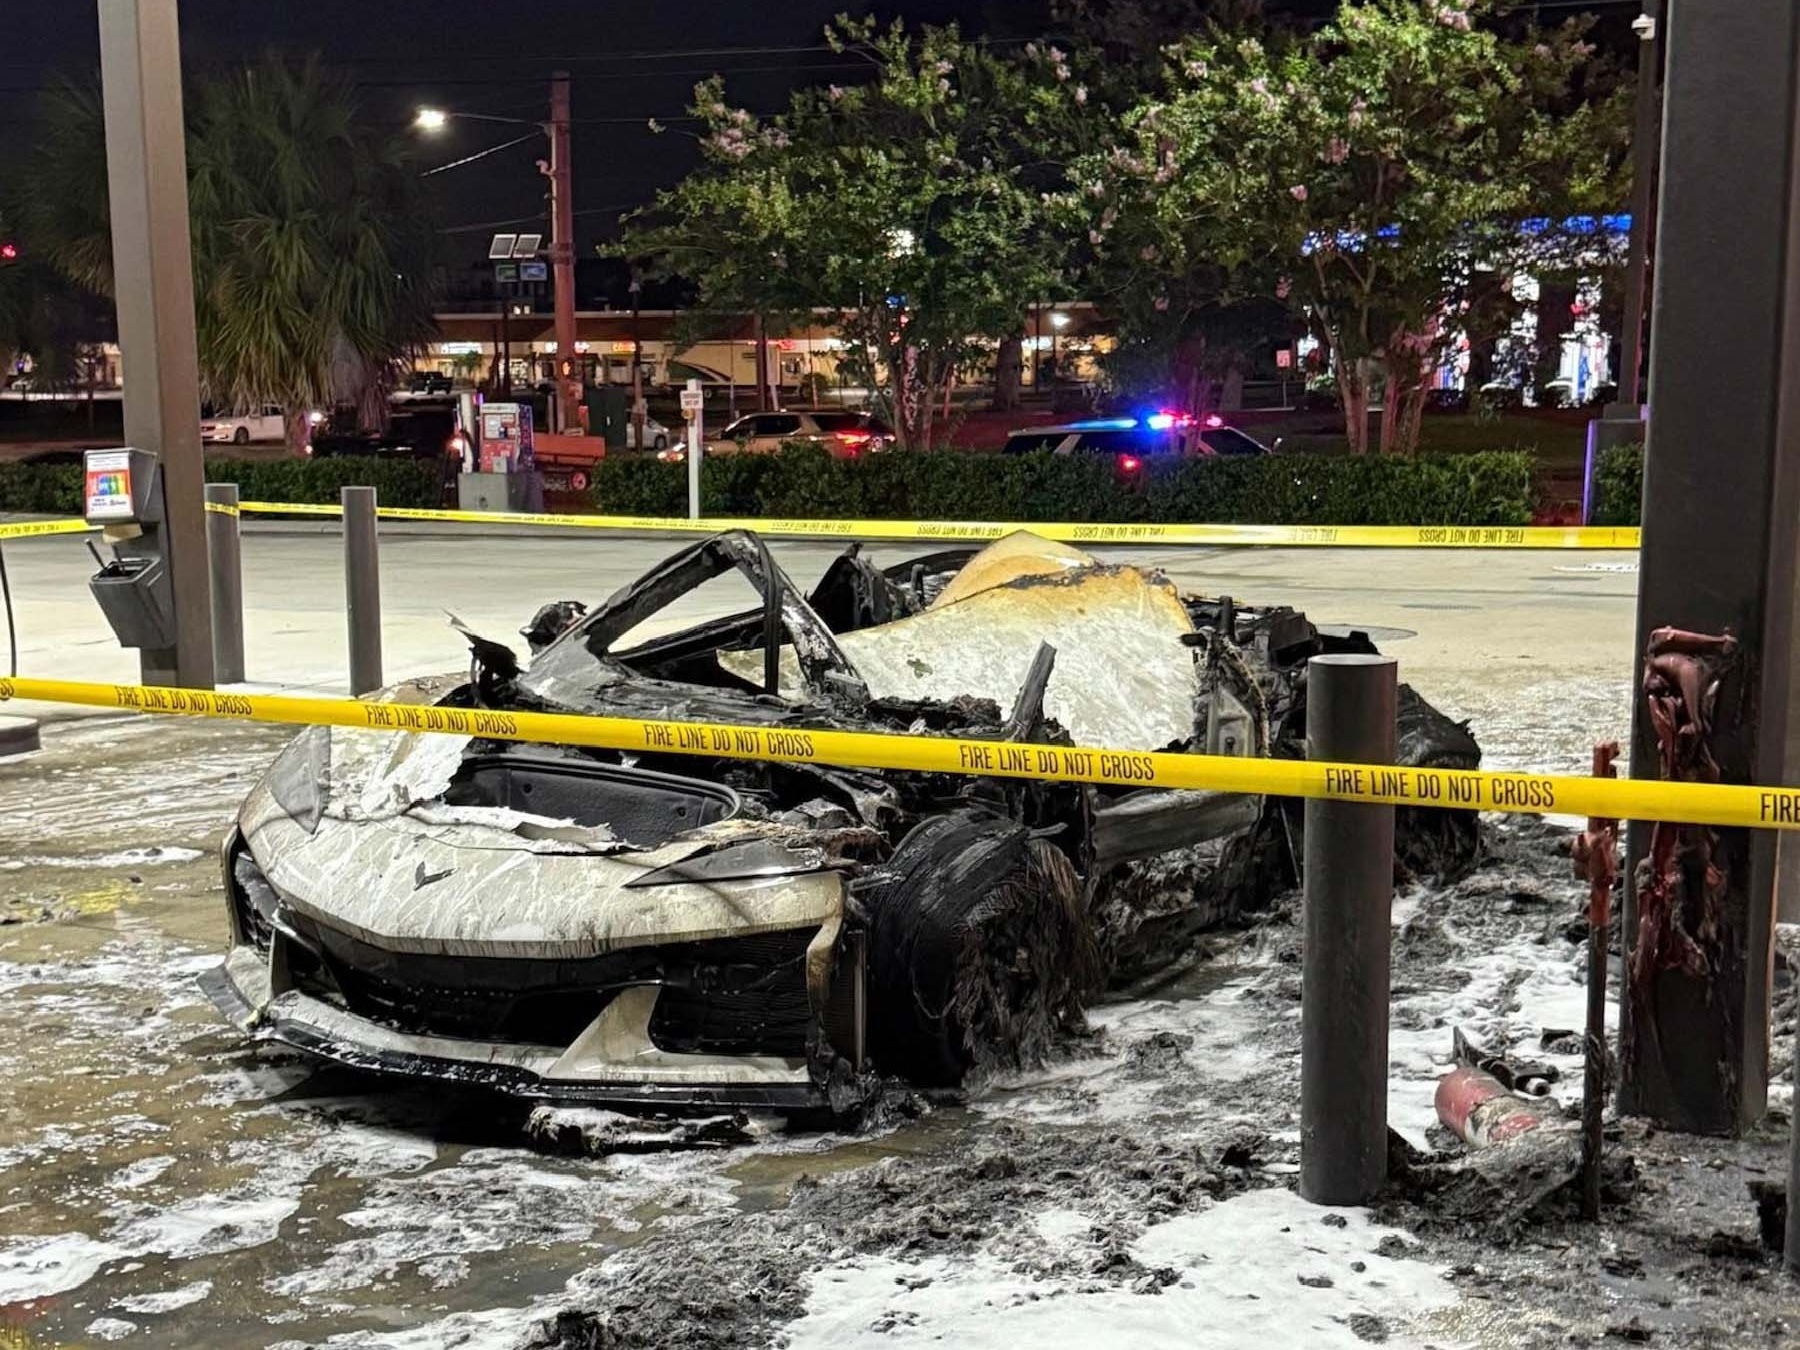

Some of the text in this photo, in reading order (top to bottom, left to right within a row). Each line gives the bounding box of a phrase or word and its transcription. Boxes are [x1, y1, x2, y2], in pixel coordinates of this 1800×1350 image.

[1418, 529, 1525, 543] FIRE LINE DO NOT CROSS
[116, 686, 253, 716] FIRE LINE DO NOT CROSS
[367, 705, 518, 735] FIRE LINE DO NOT CROSS
[645, 725, 815, 758] FIRE LINE DO NOT CROSS
[960, 745, 1155, 781] FIRE LINE DO NOT CROSS
[1326, 768, 1555, 808] FIRE LINE DO NOT CROSS
[1761, 793, 1800, 823] FIRE
